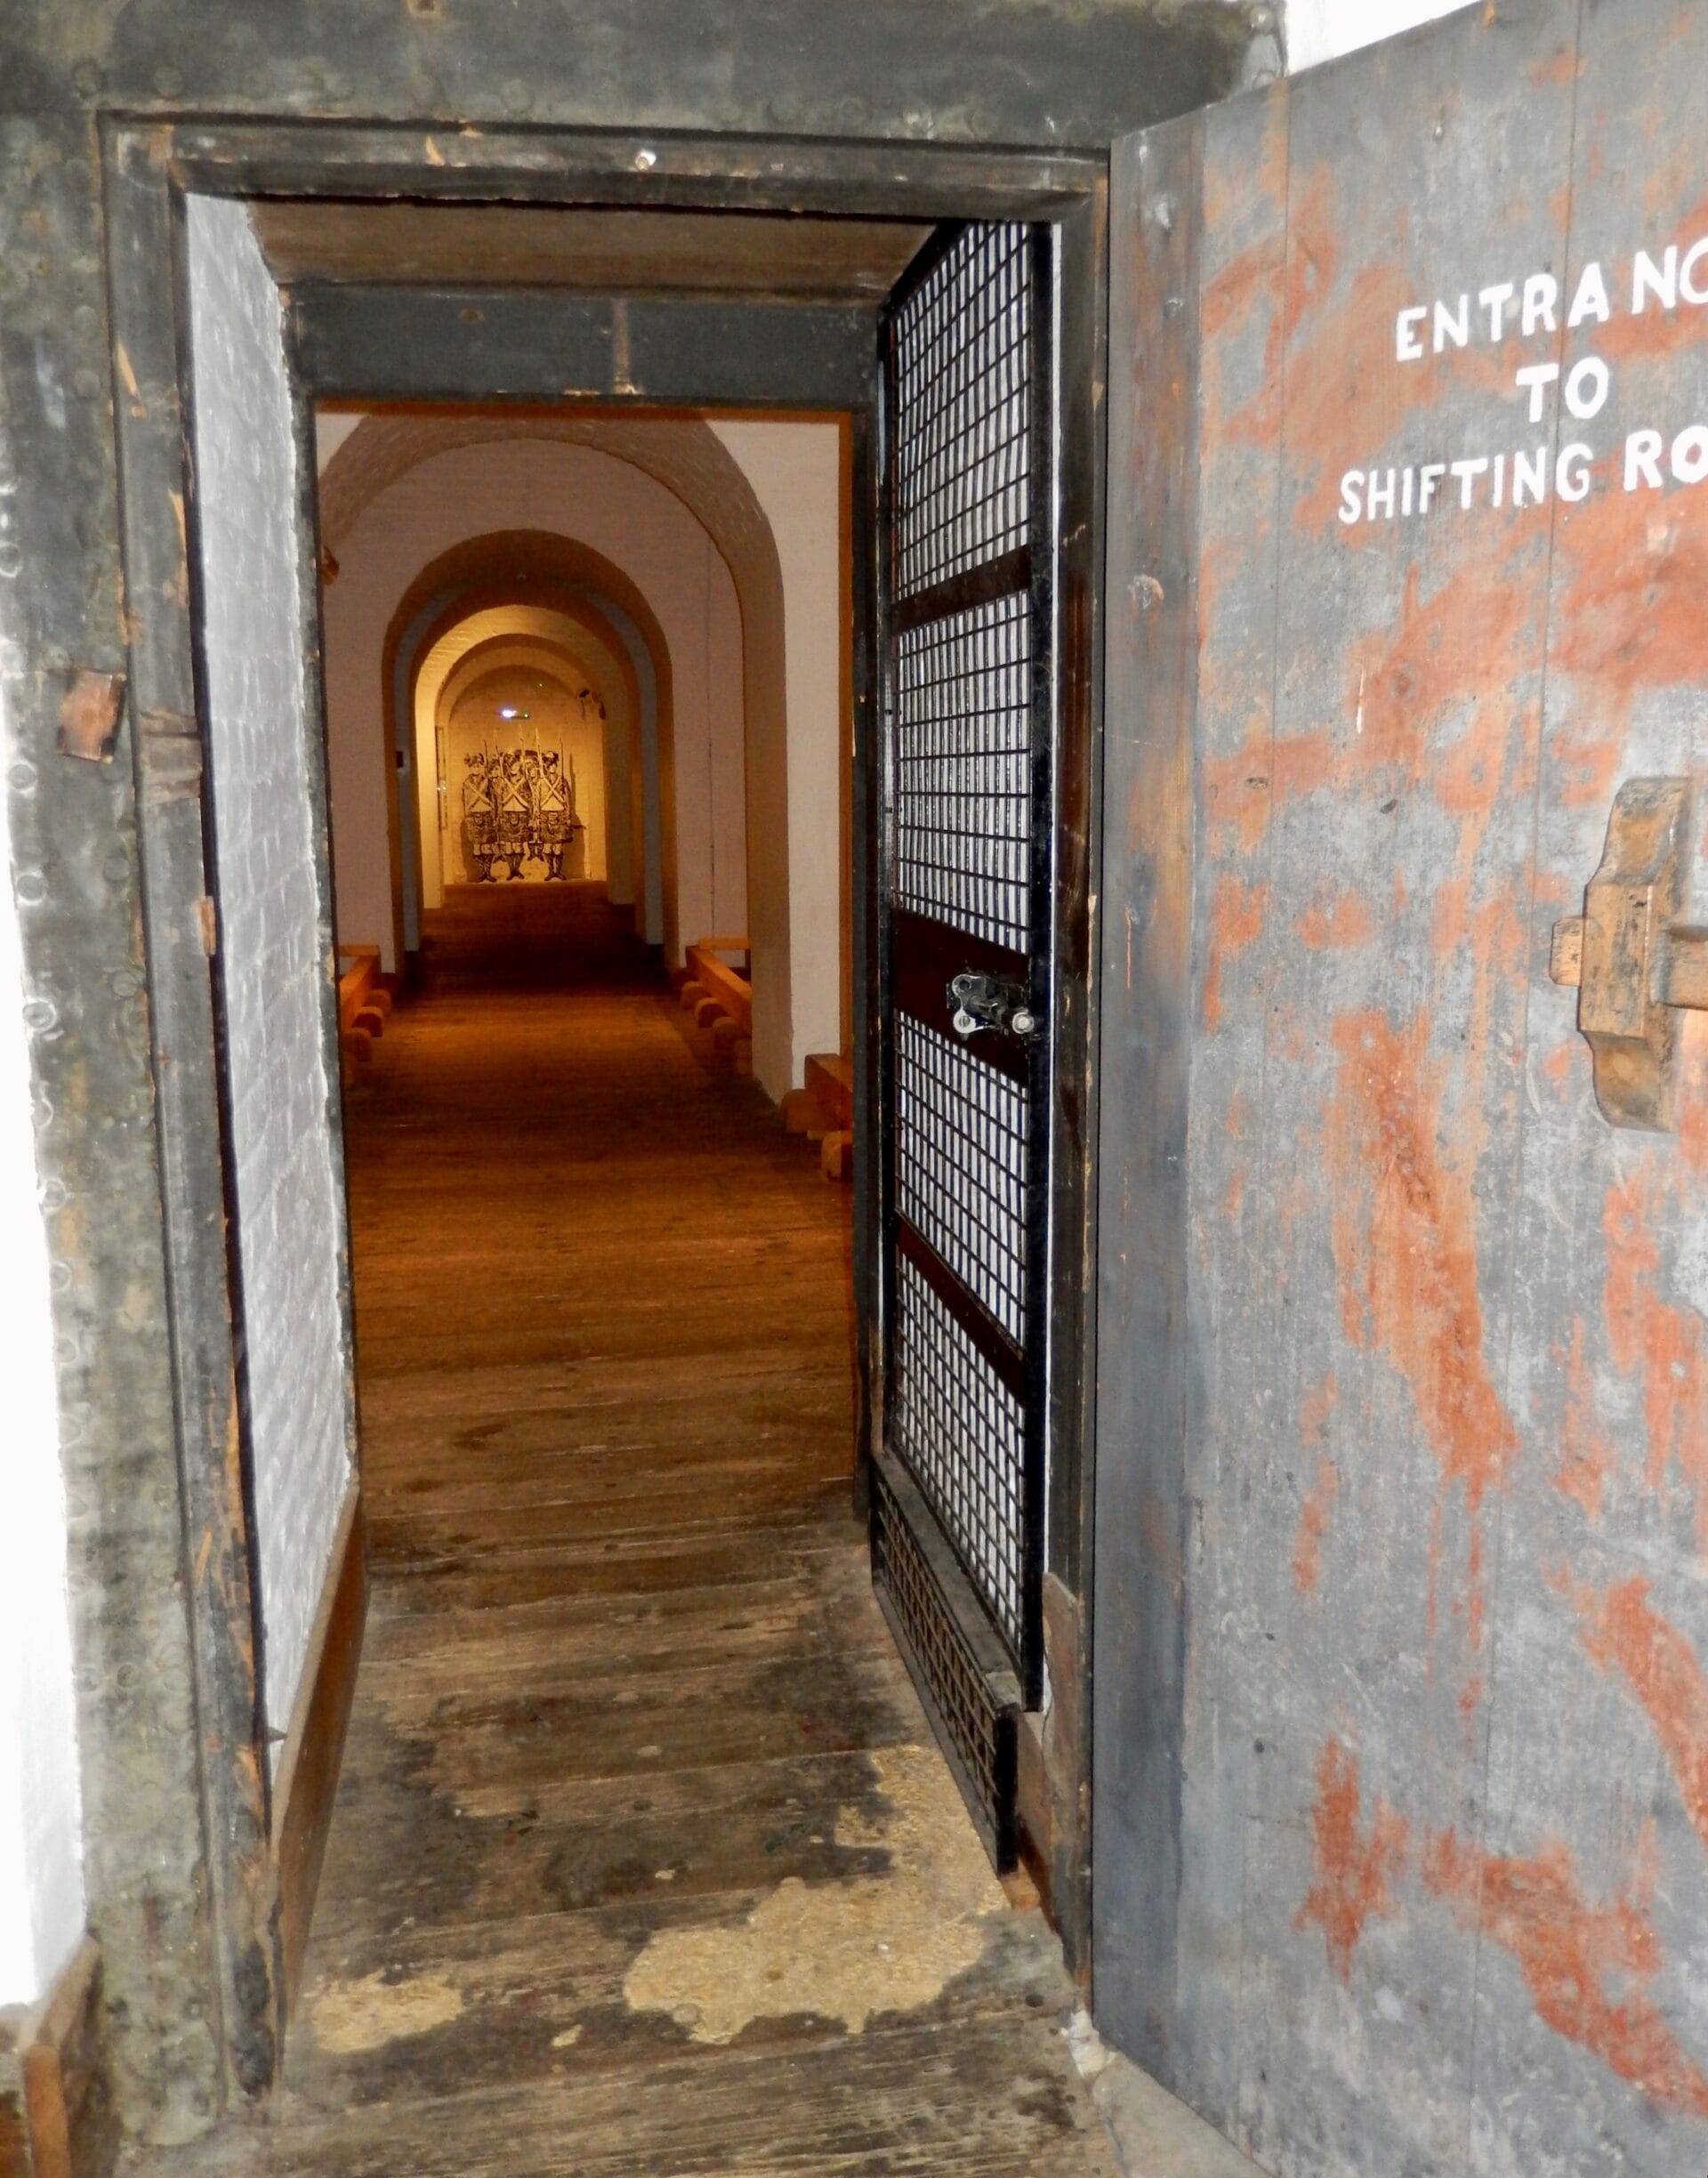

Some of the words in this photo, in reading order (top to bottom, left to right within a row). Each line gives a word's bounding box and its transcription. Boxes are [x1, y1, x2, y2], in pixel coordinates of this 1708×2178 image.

[1515, 356, 1609, 424] TO
[1338, 443, 1594, 524] SHIFTING
[1623, 424, 1708, 491] RO
